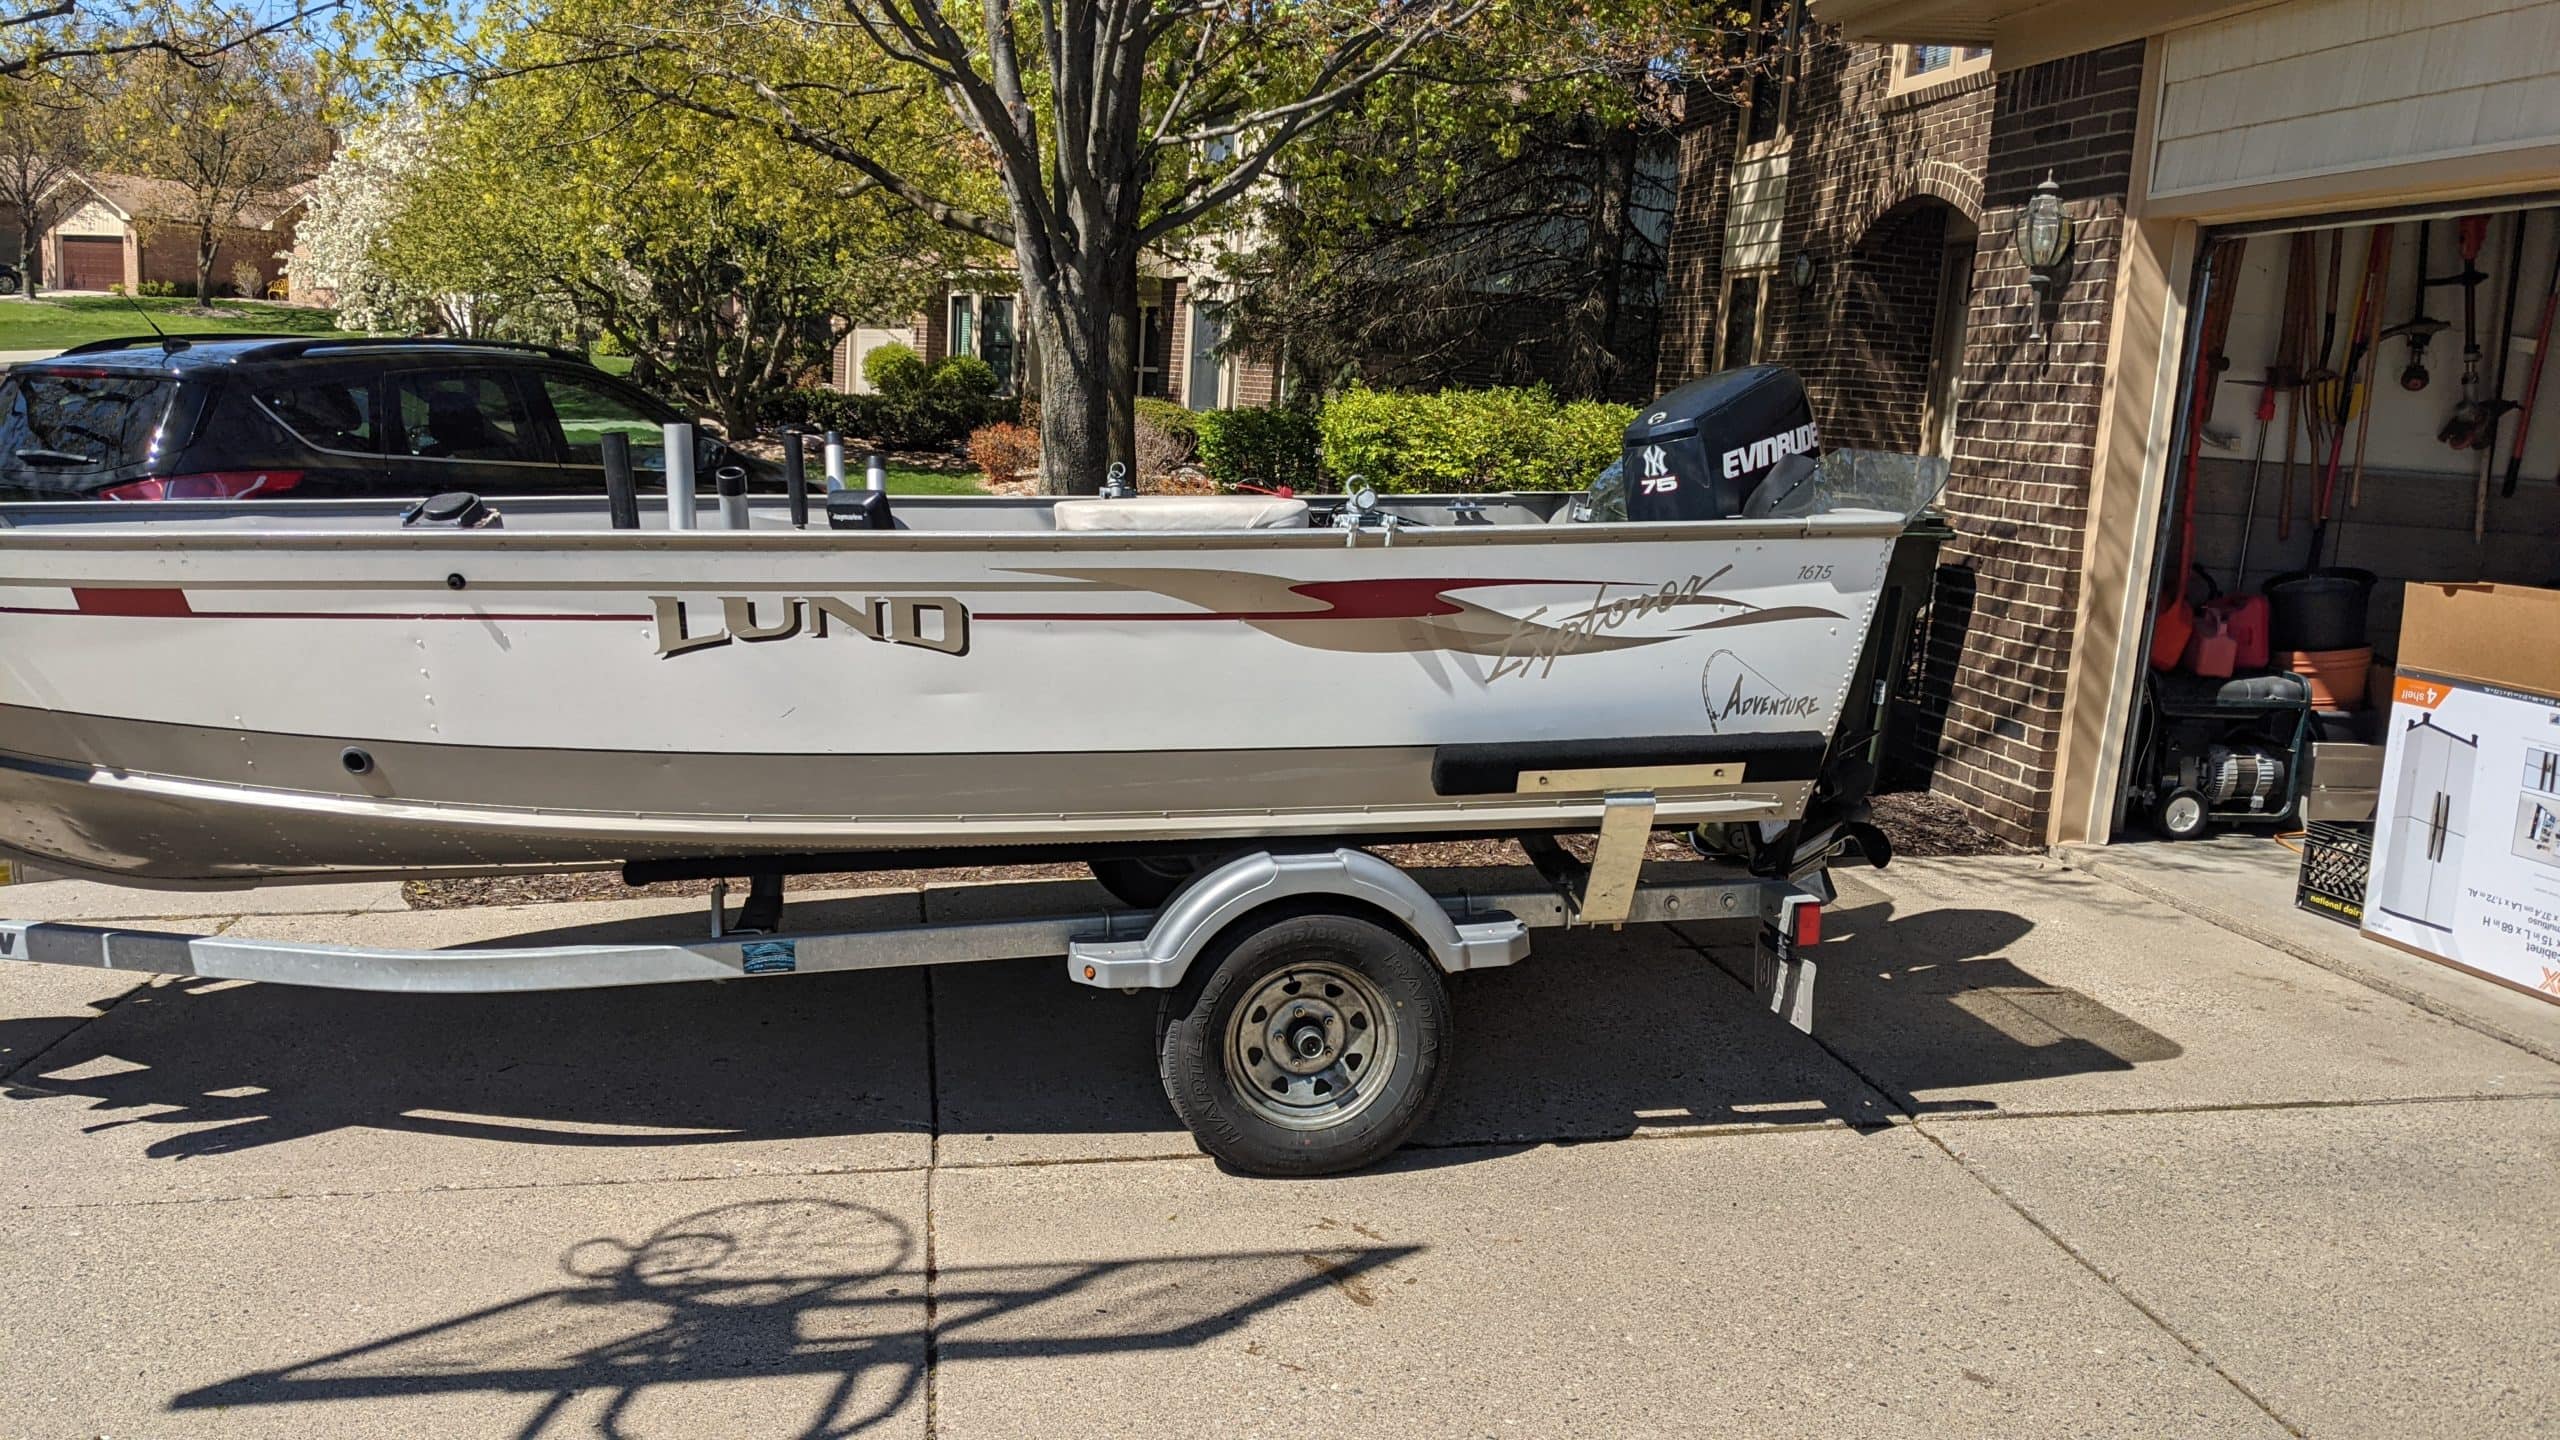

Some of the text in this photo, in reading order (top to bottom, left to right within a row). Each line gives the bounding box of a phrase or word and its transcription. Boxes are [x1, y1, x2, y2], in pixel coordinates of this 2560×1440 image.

[1722, 421, 1820, 480] EVINRUDE
[1640, 475, 1679, 495] 75
[1797, 564, 1835, 580] 1675
[648, 596, 971, 661] LUND
[1485, 564, 1733, 685] Explorer
[1720, 673, 1820, 721] ADVENTURE
[2401, 688, 2438, 705] 4 shelf
[2310, 895, 2343, 912] national
[2482, 915, 2491, 928] H
[2501, 922, 2514, 934] 68
[2524, 929, 2531, 940] L
[2541, 935, 2553, 948] 15
[1383, 952, 1438, 1075] RADIAL
